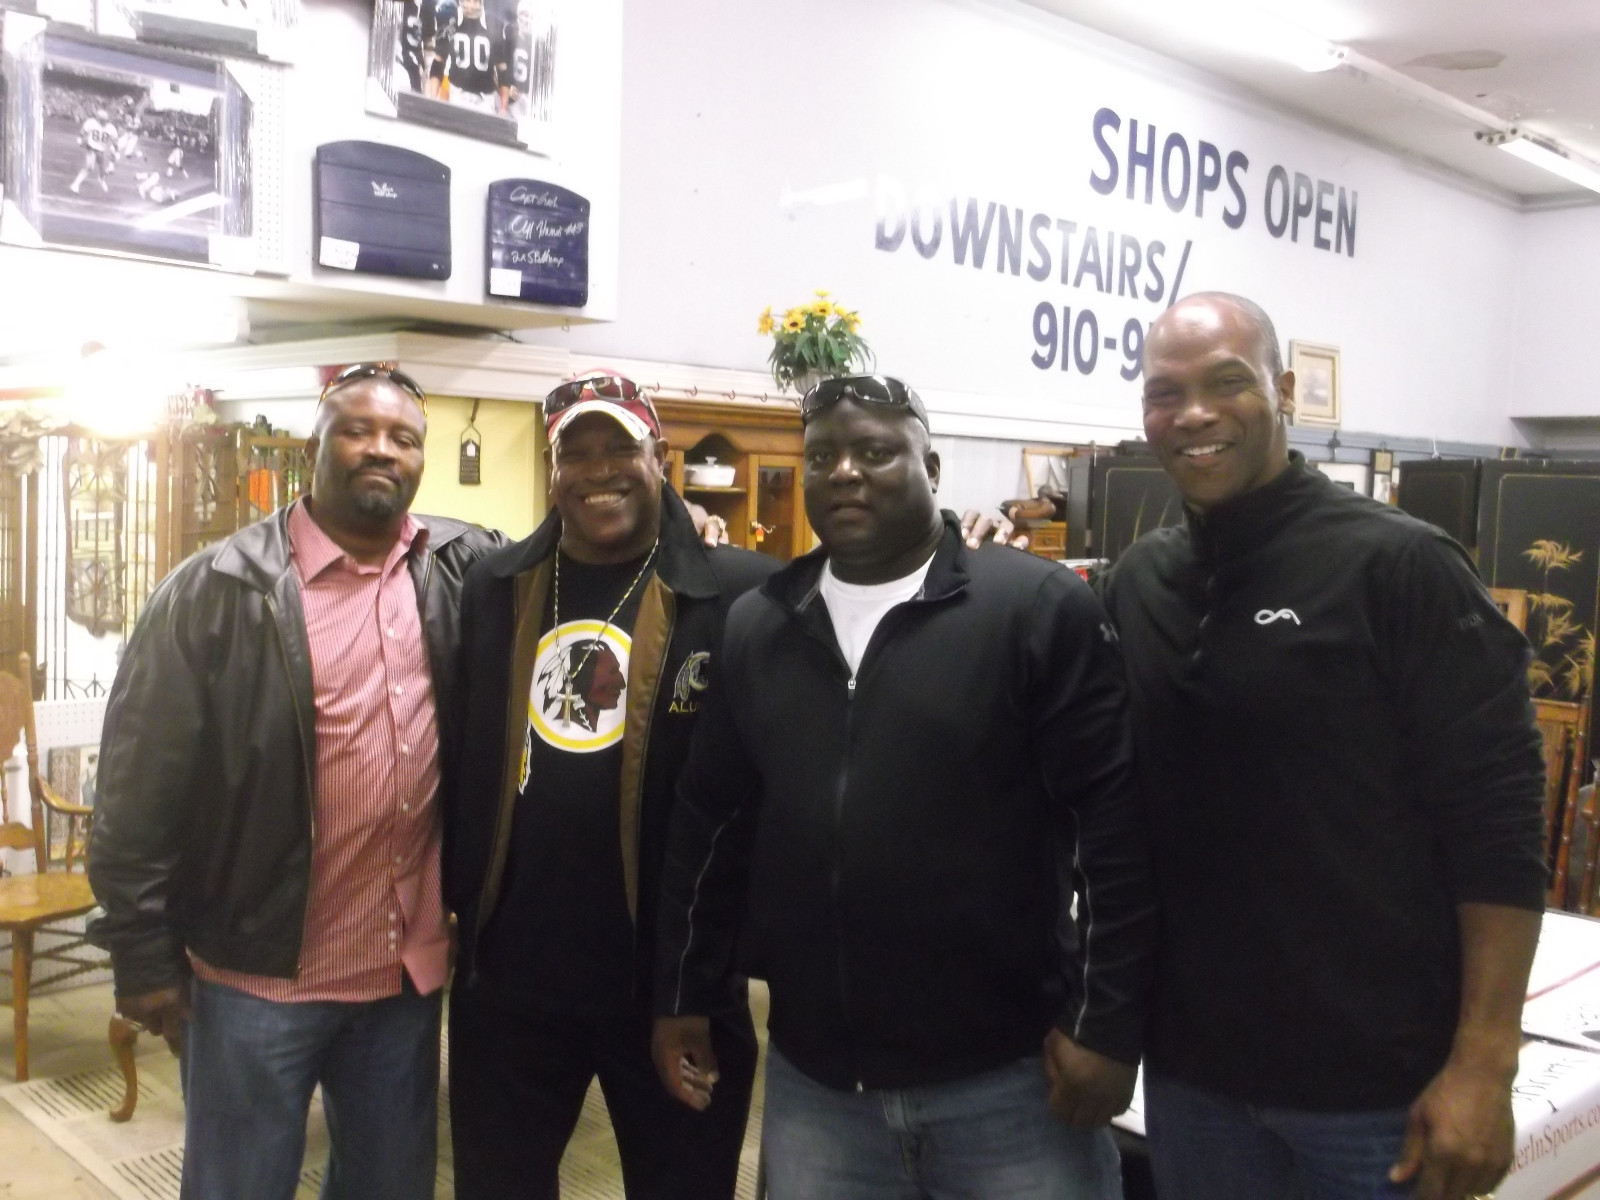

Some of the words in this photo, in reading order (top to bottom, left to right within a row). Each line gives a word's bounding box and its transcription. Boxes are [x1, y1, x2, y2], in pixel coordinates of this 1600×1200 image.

[1089, 107, 1249, 230] SHOPS
[1264, 164, 1358, 258] OPEN
[875, 180, 1193, 308] DOWNSTAIRS/
[1031, 301, 1154, 382] 910-9
[668, 701, 700, 713] ALU
